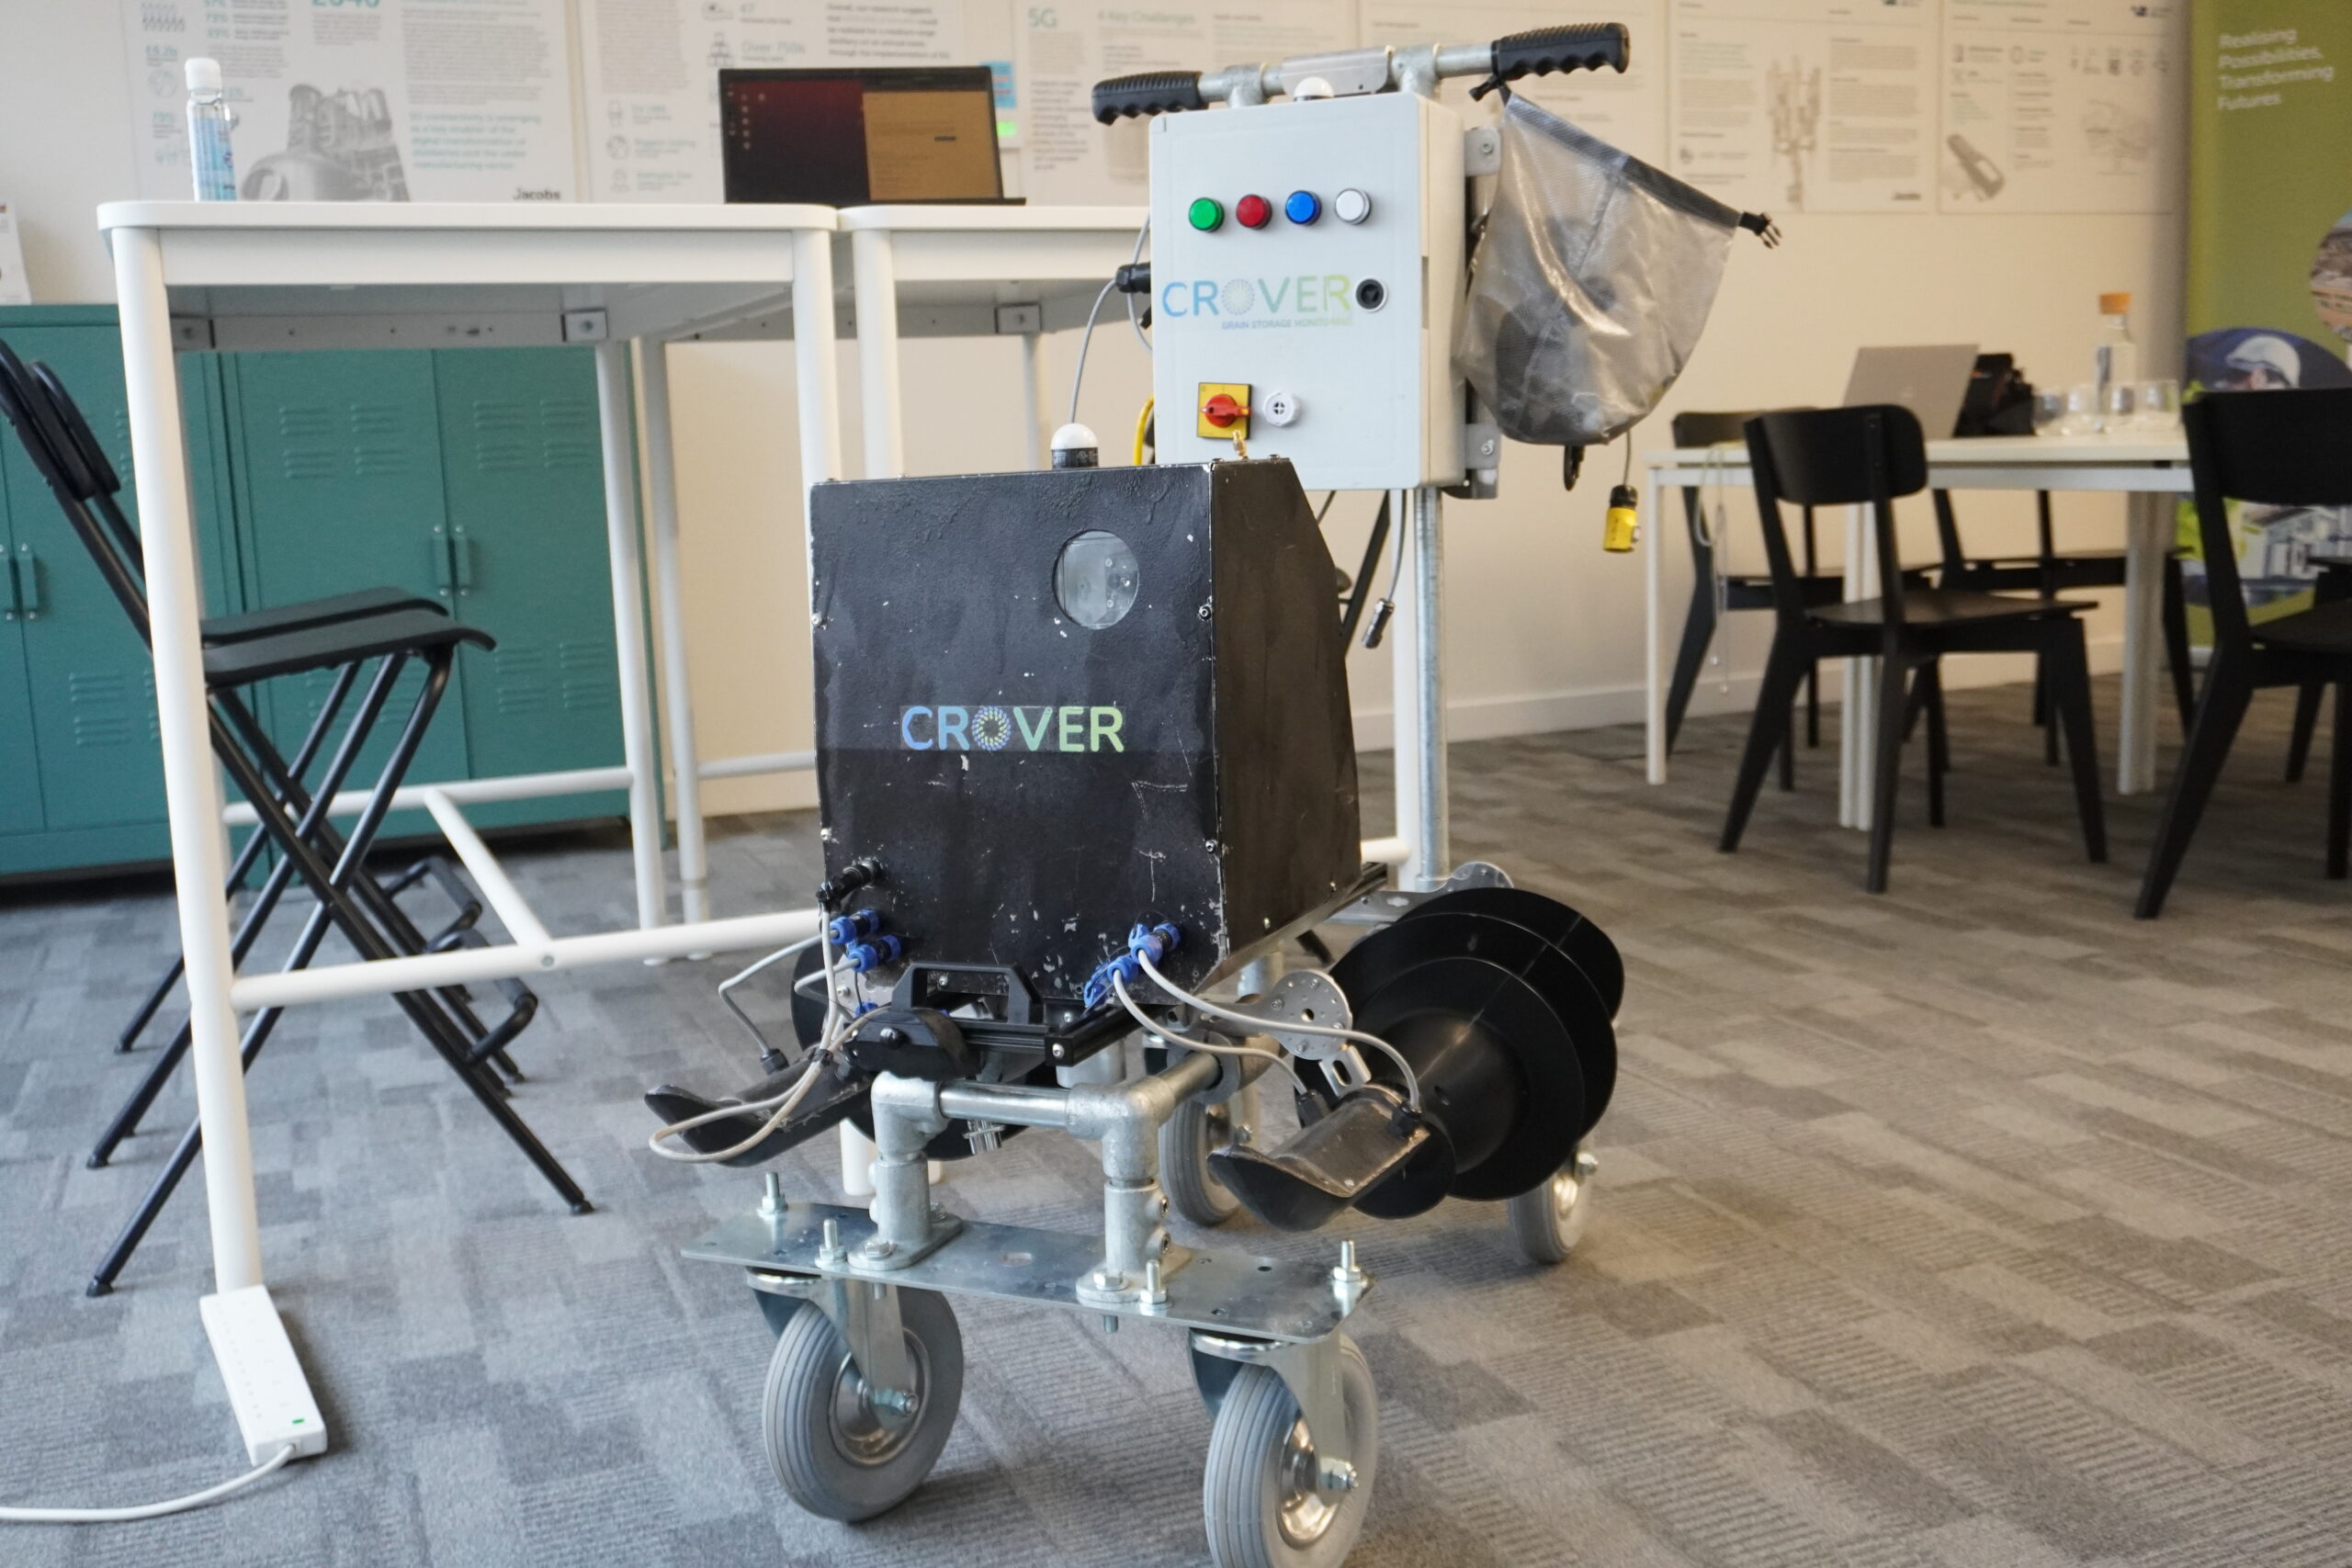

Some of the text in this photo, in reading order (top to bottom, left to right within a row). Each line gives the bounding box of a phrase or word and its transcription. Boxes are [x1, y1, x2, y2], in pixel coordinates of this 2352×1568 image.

[1027, 7, 1058, 28] 5G
[513, 188, 561, 200] Jacobs
[1161, 274, 1352, 317] CROVER
[901, 705, 1125, 751] CROVER
